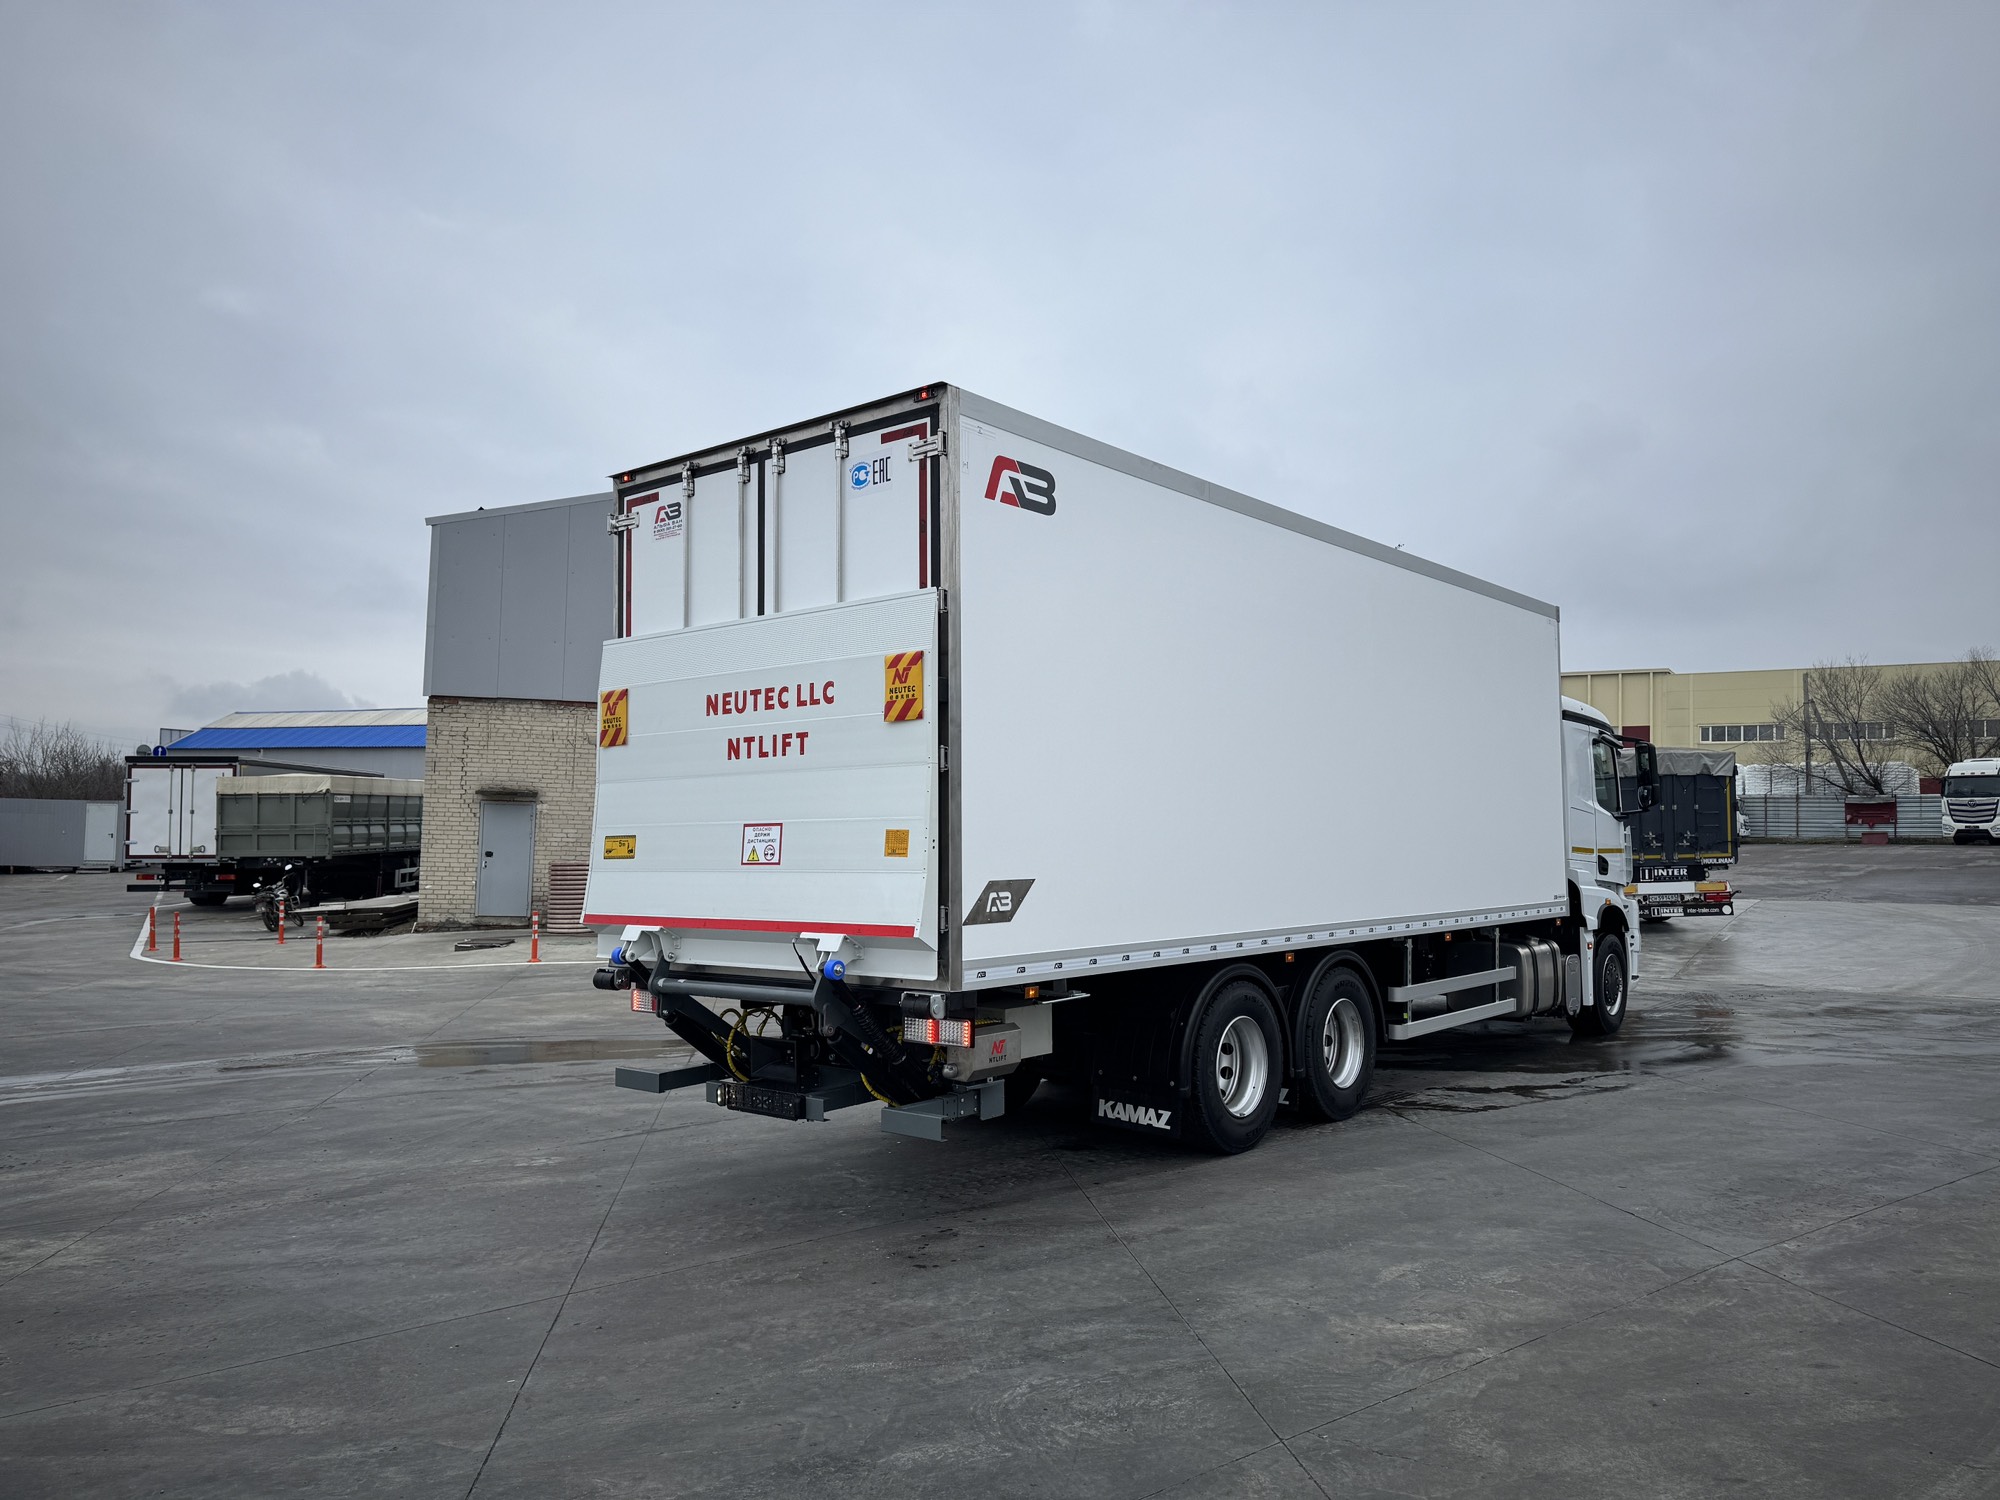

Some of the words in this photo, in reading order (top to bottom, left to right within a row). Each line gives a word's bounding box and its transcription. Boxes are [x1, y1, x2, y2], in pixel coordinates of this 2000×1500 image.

[706, 686, 789, 716] NEUTEC
[796, 680, 835, 707] LLC
[888, 685, 916, 694] NEUTEC
[727, 731, 809, 760] NTLIFT
[1654, 868, 1688, 876] INTER
[988, 1054, 1007, 1063] NTLIFT
[1098, 1098, 1172, 1130] KAMAZ
